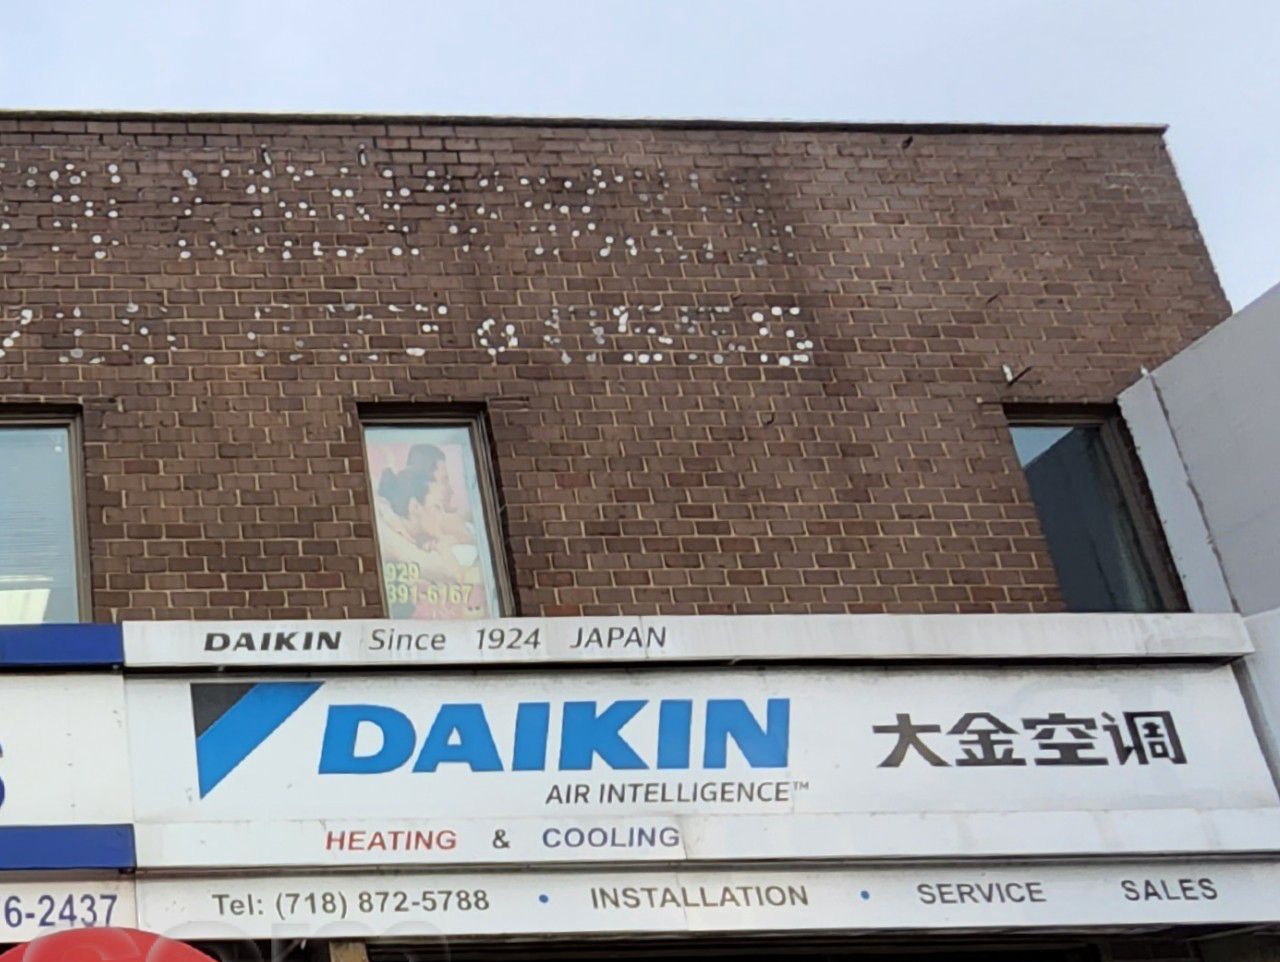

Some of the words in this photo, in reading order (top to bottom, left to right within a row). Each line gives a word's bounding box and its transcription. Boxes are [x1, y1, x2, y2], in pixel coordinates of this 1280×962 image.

[384, 562, 419, 582] 929
[204, 631, 341, 652] DAIKIN
[368, 628, 446, 651] Since
[477, 627, 541, 650] 1924
[569, 626, 667, 649] JAPAN
[318, 698, 790, 774] DAIKIN
[872, 710, 1187, 768] 大金空调
[545, 784, 590, 804] AIR
[326, 830, 458, 851] HEATING
[492, 829, 511, 849] &
[542, 827, 680, 848] COOLING
[212, 893, 263, 916] Tel:
[276, 891, 348, 918] (718)
[359, 890, 490, 913] 872-5788
[591, 885, 809, 909] INSTALLATION
[917, 881, 1047, 904] SERVICE
[1120, 878, 1218, 901] SALES
